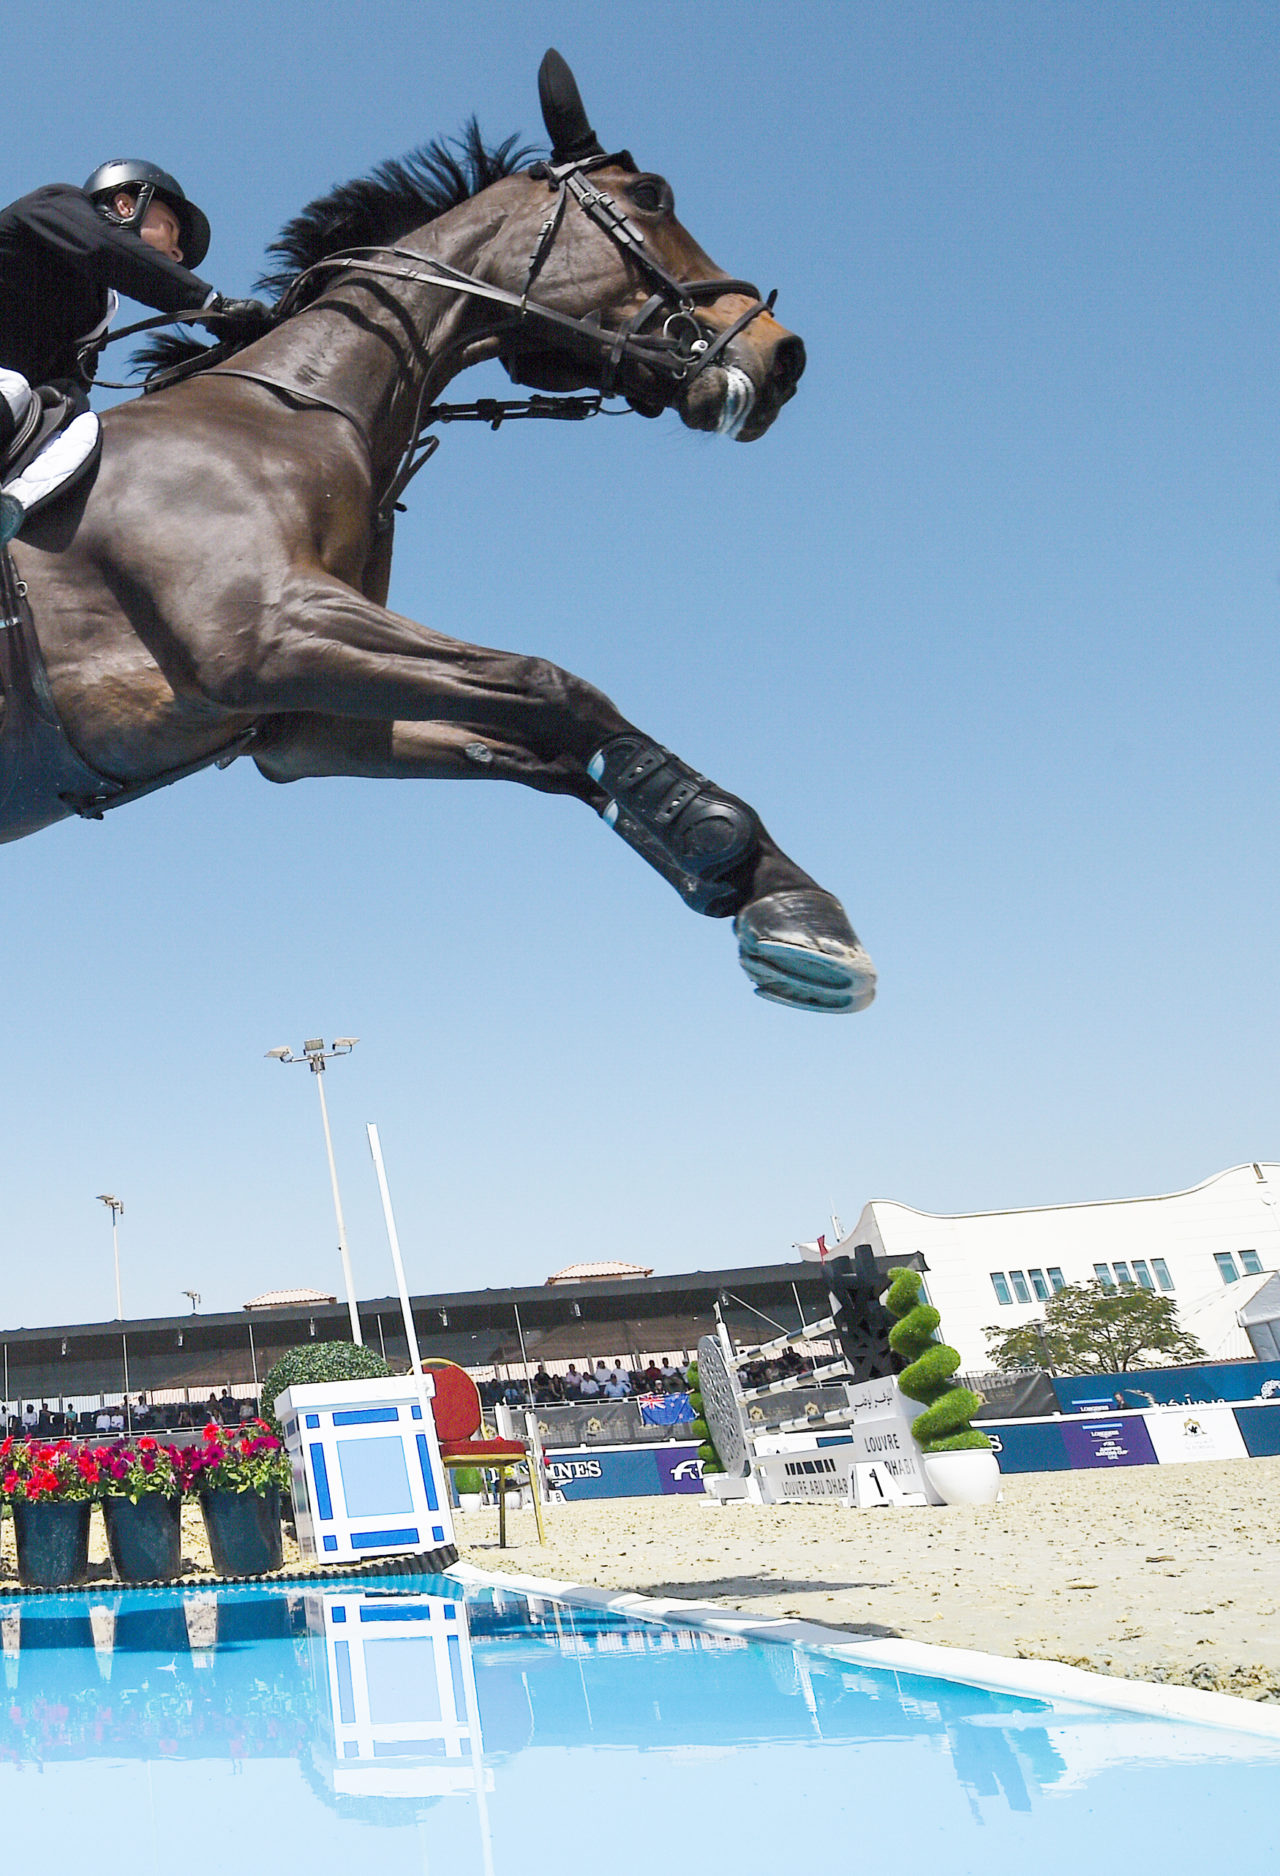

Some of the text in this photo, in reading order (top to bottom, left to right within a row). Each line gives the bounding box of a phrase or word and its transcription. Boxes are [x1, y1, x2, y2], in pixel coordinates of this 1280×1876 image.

[864, 1433, 901, 1454] LOUVRE
[781, 1478, 849, 1496] LOUVRE ABU DHAB
[869, 1468, 884, 1498] 1
